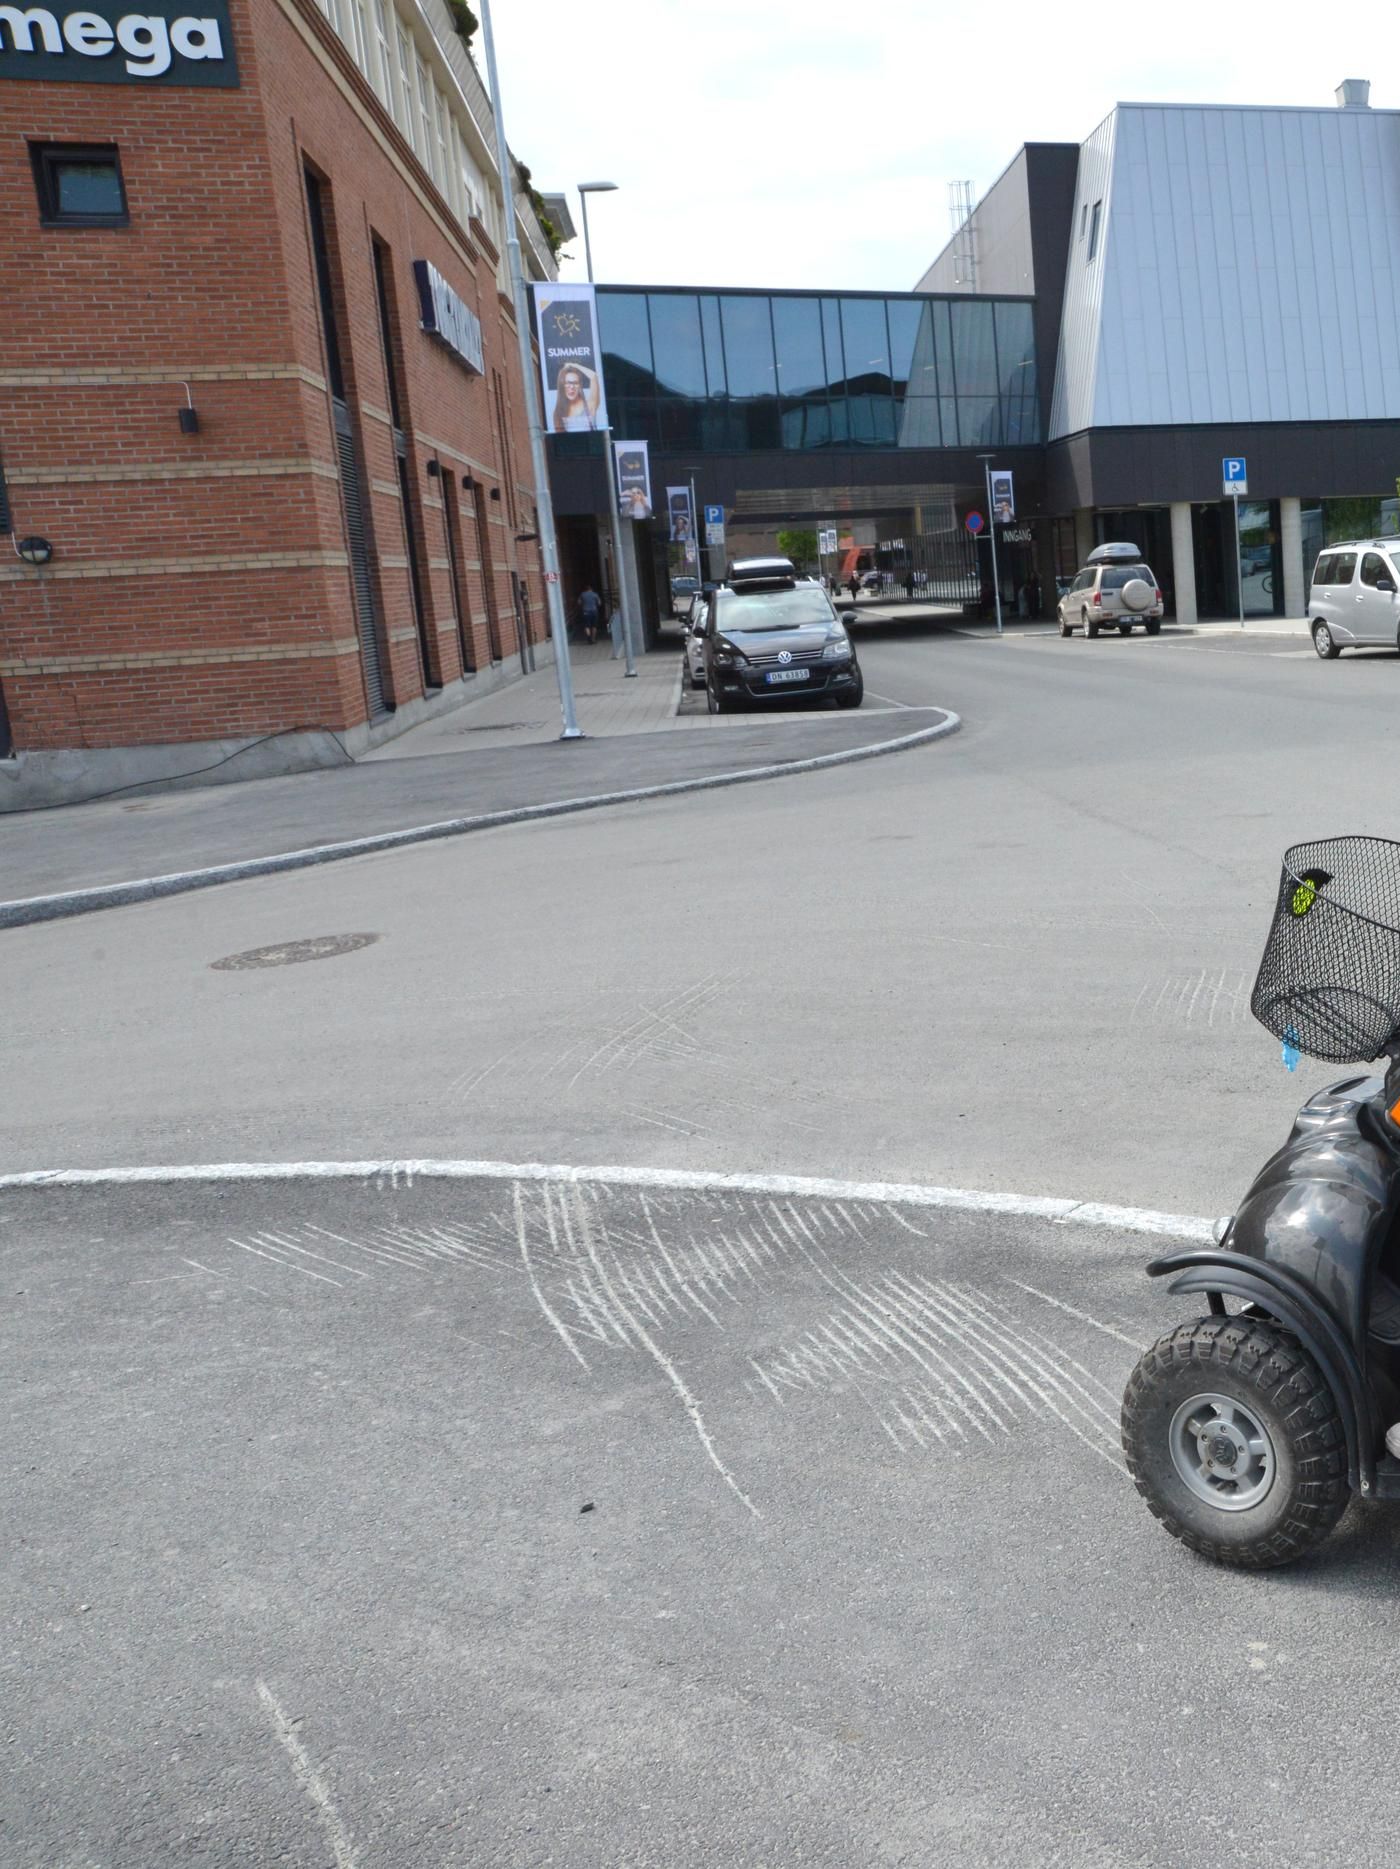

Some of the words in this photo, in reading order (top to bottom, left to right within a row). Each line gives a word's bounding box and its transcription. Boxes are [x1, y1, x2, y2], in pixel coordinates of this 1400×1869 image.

[0, 5, 224, 77] mega
[548, 346, 591, 357] SUMMER
[1228, 461, 1240, 479] P
[708, 507, 719, 522] P
[1002, 528, 1032, 543] INNGANG
